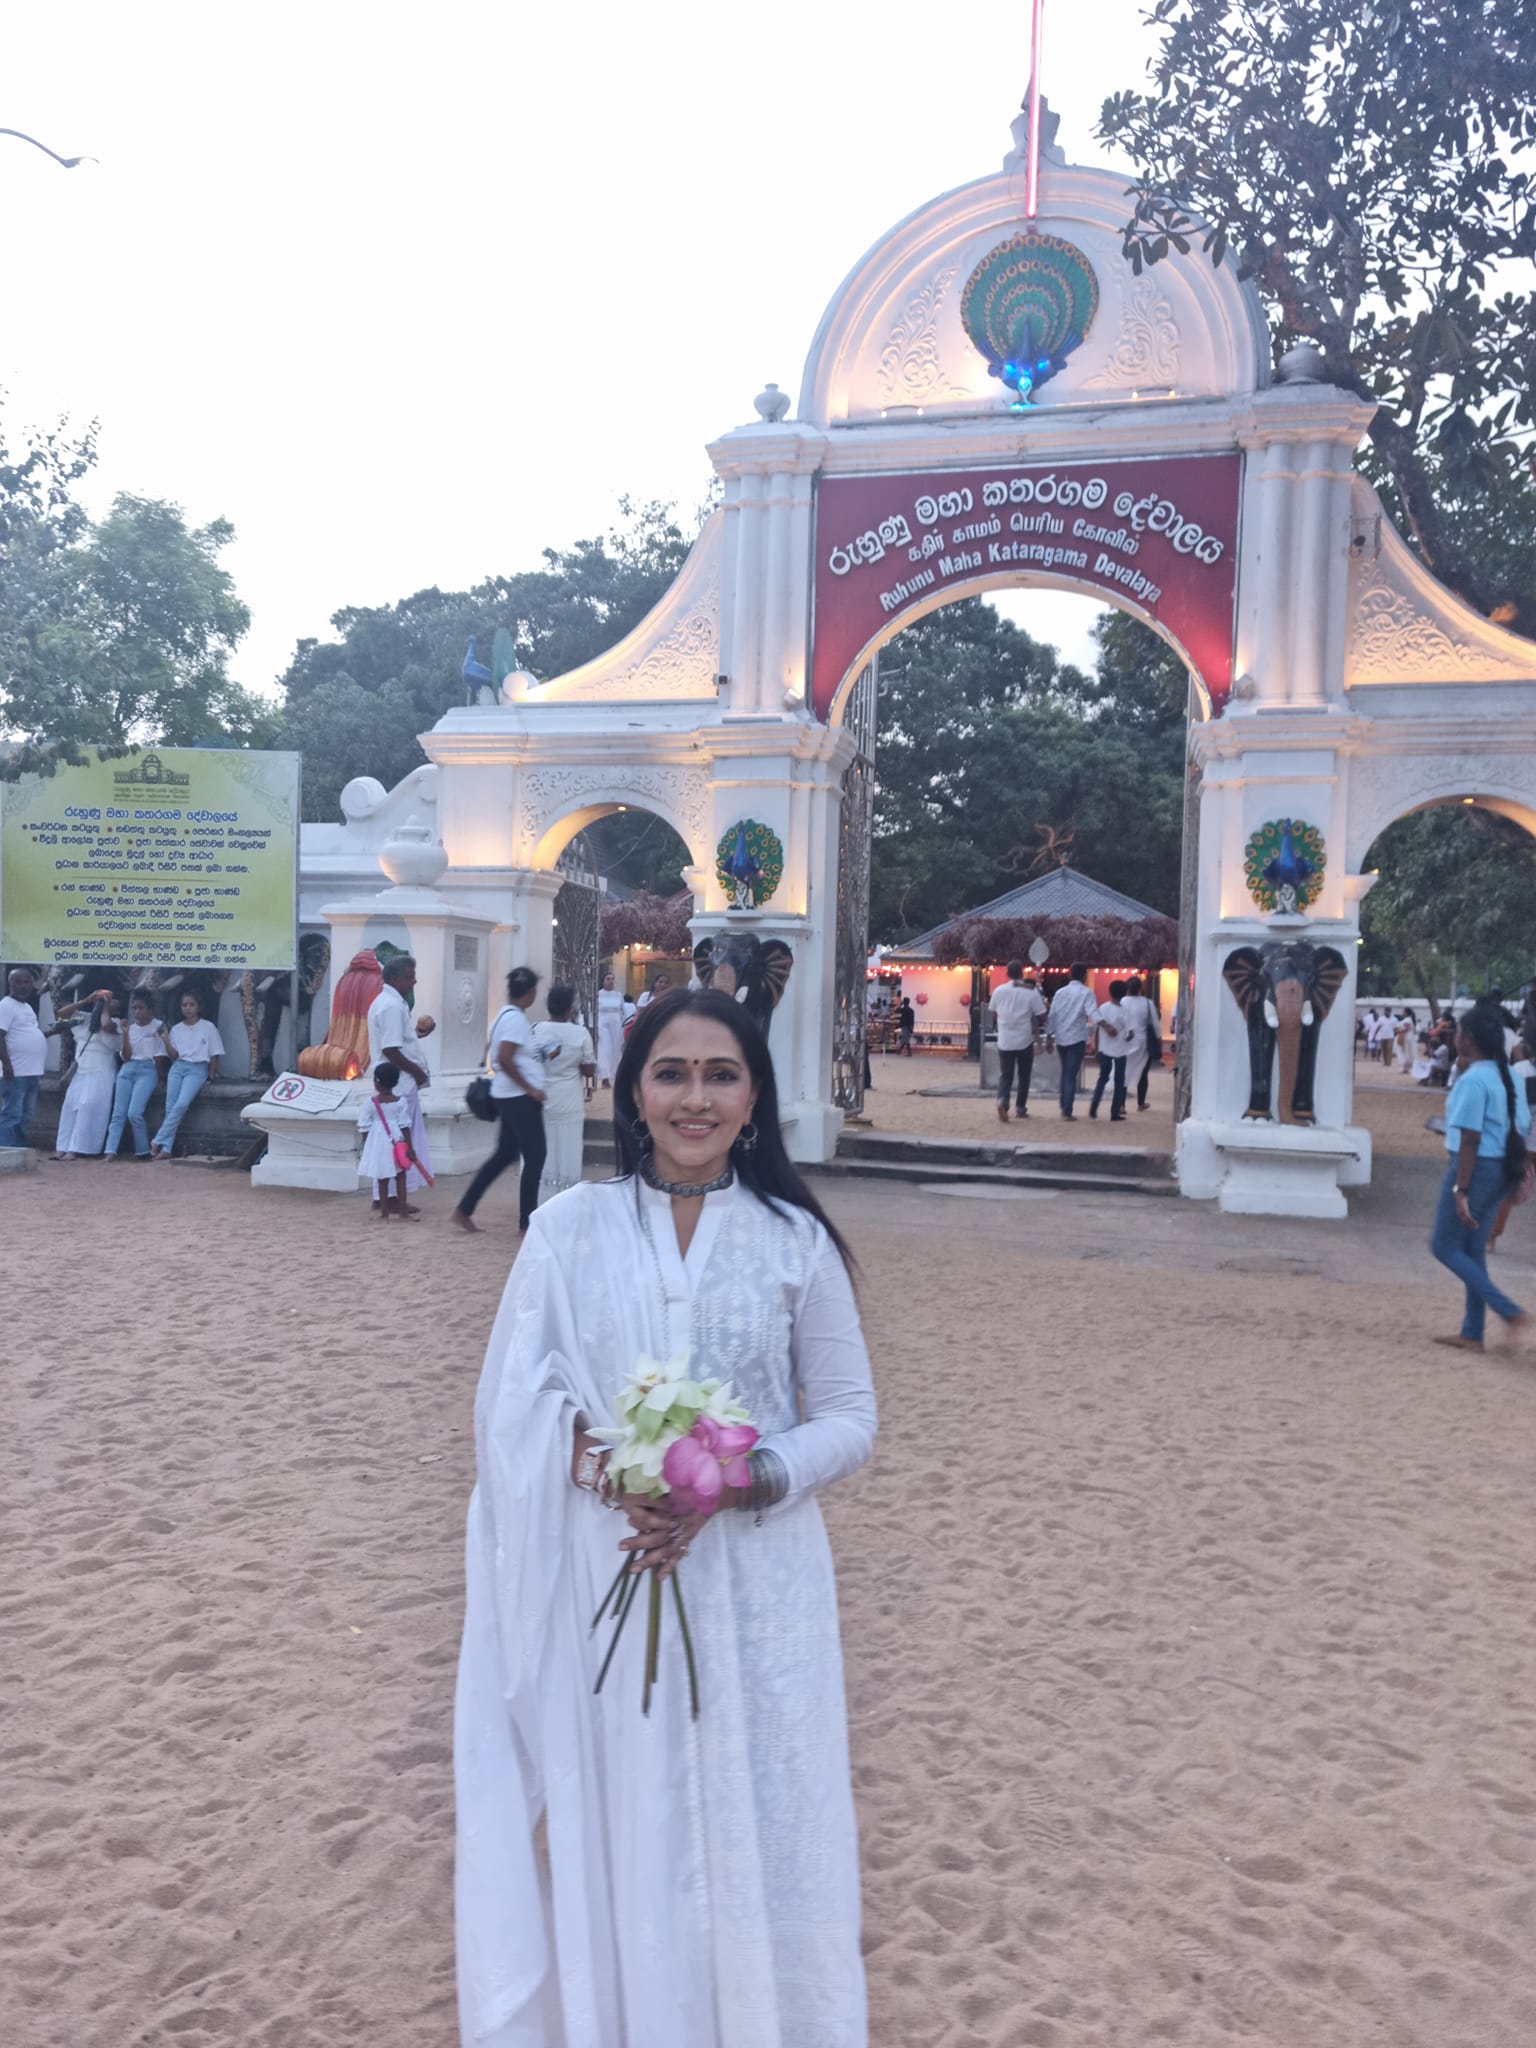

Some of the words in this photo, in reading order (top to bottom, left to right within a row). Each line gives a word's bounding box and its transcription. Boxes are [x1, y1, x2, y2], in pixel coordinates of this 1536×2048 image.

[829, 515, 913, 575] රුහුණු
[915, 487, 973, 525] මහා
[983, 474, 1108, 509] කතරගම
[1113, 492, 1223, 564] දේවාලය
[908, 525, 945, 562] கதிர்
[952, 513, 1001, 544] காமம்
[1010, 512, 1064, 536] பெரிய
[1072, 518, 1140, 555] கோவில்
[879, 569, 935, 612] Ruhunu
[940, 550, 982, 578] Maha
[989, 541, 1087, 569] Kataragama
[1094, 554, 1162, 603] Devalaya
[64, 806, 101, 820] රුහුණු
[106, 807, 129, 819] මහා
[134, 809, 182, 820] කතරගම
[186, 809, 238, 823] දේවාලයේ
